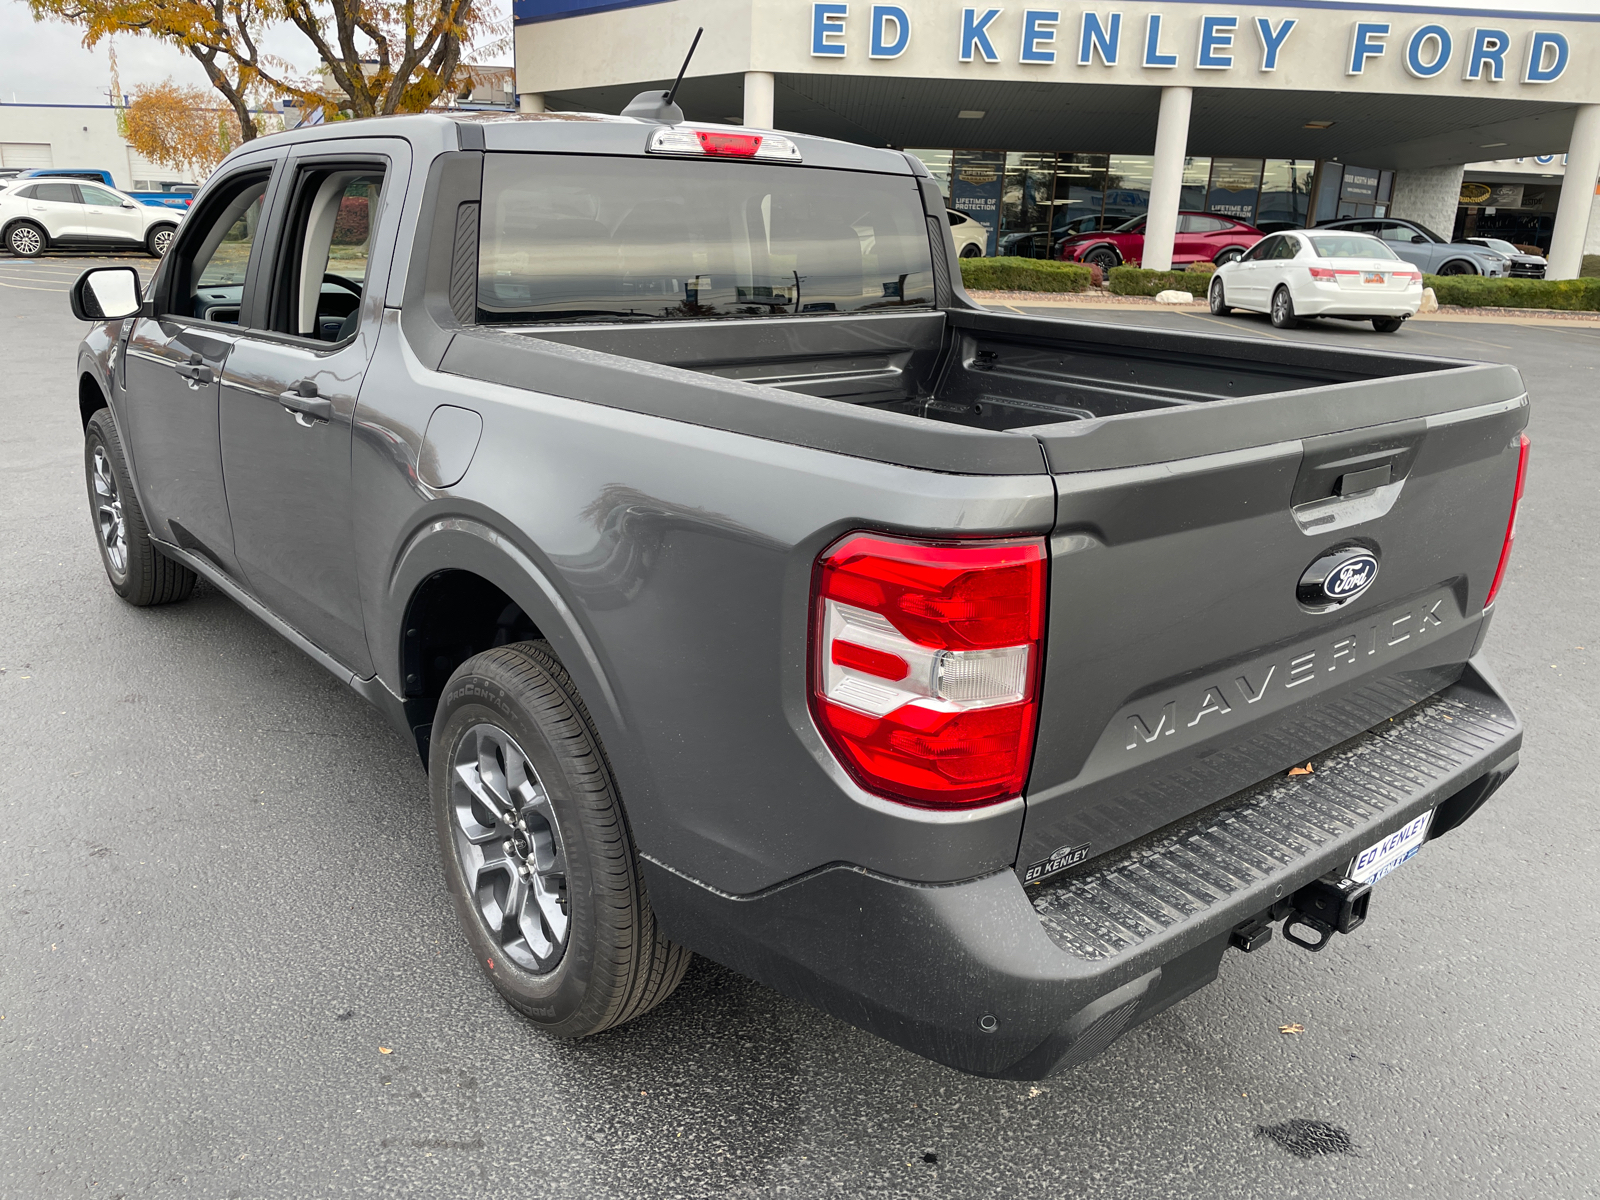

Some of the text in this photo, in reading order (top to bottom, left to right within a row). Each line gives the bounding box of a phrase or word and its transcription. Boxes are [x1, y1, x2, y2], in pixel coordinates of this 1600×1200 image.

[810, 2, 1570, 84] ED KENLEY FORD
[1334, 562, 1370, 593] Ford
[1126, 600, 1442, 750] MAVERICK
[1025, 866, 1042, 880] ED
[1044, 848, 1090, 873] KENLEY
[1357, 847, 1379, 870] ED
[1379, 813, 1429, 857] KENLEY
